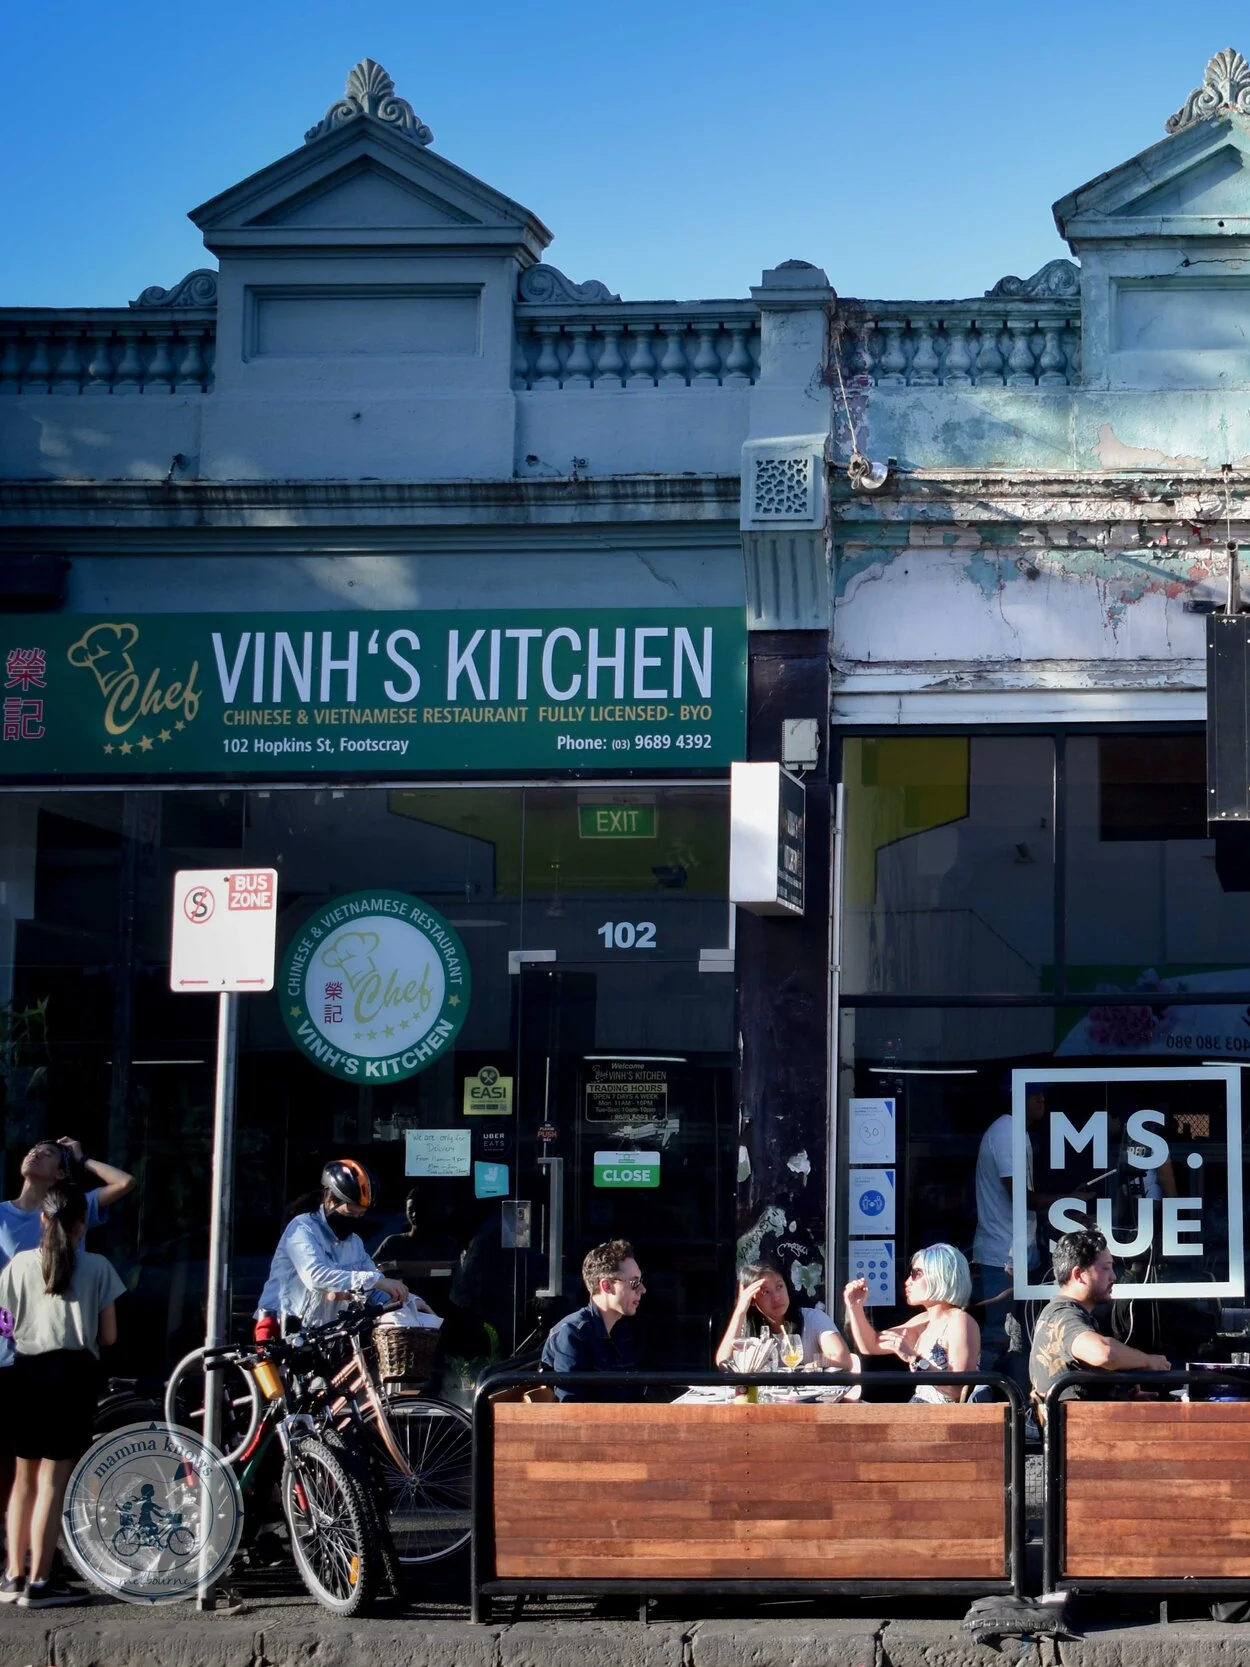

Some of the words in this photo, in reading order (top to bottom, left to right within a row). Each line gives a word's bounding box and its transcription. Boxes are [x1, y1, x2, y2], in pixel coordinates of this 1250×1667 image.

[211, 629, 421, 703] VINH'S
[447, 627, 713, 701] KITCHEN
[104, 660, 203, 735] Chef
[223, 709, 292, 726] CHINESE
[296, 708, 309, 725] &
[314, 708, 417, 725] VIETNAMESE
[423, 706, 528, 723] RESTAURANT
[539, 705, 585, 722] FULLY
[680, 705, 712, 721] BYO
[223, 738, 248, 753] 102
[254, 738, 312, 756] Hopkins
[317, 738, 334, 754] St,
[340, 738, 409, 755] Footscray
[557, 735, 607, 750] Phone:
[612, 739, 631, 751] (03)
[635, 734, 671, 749] 9689
[676, 734, 712, 749] 4392
[596, 810, 639, 832] EXIT
[235, 874, 268, 891] BUS
[230, 892, 271, 908] ZONE
[597, 921, 657, 949] 102
[288, 938, 315, 997] CHINESE
[310, 926, 323, 938] &
[320, 898, 409, 929] VIETNAMESE
[409, 906, 463, 985] RESTAURANT
[354, 961, 434, 1024] Chef
[296, 1020, 359, 1076] VINH'S
[365, 1018, 454, 1077] KITCHEN
[611, 1062, 645, 1070] Welcome
[635, 1070, 667, 1080] KITCHEN
[471, 1087, 506, 1099] EASI
[589, 1084, 629, 1092] TRADING
[631, 1084, 663, 1092] HOURS
[1050, 1109, 1204, 1169] MS.
[602, 1169, 651, 1182] CLOSE
[1048, 1197, 1204, 1258] SUE
